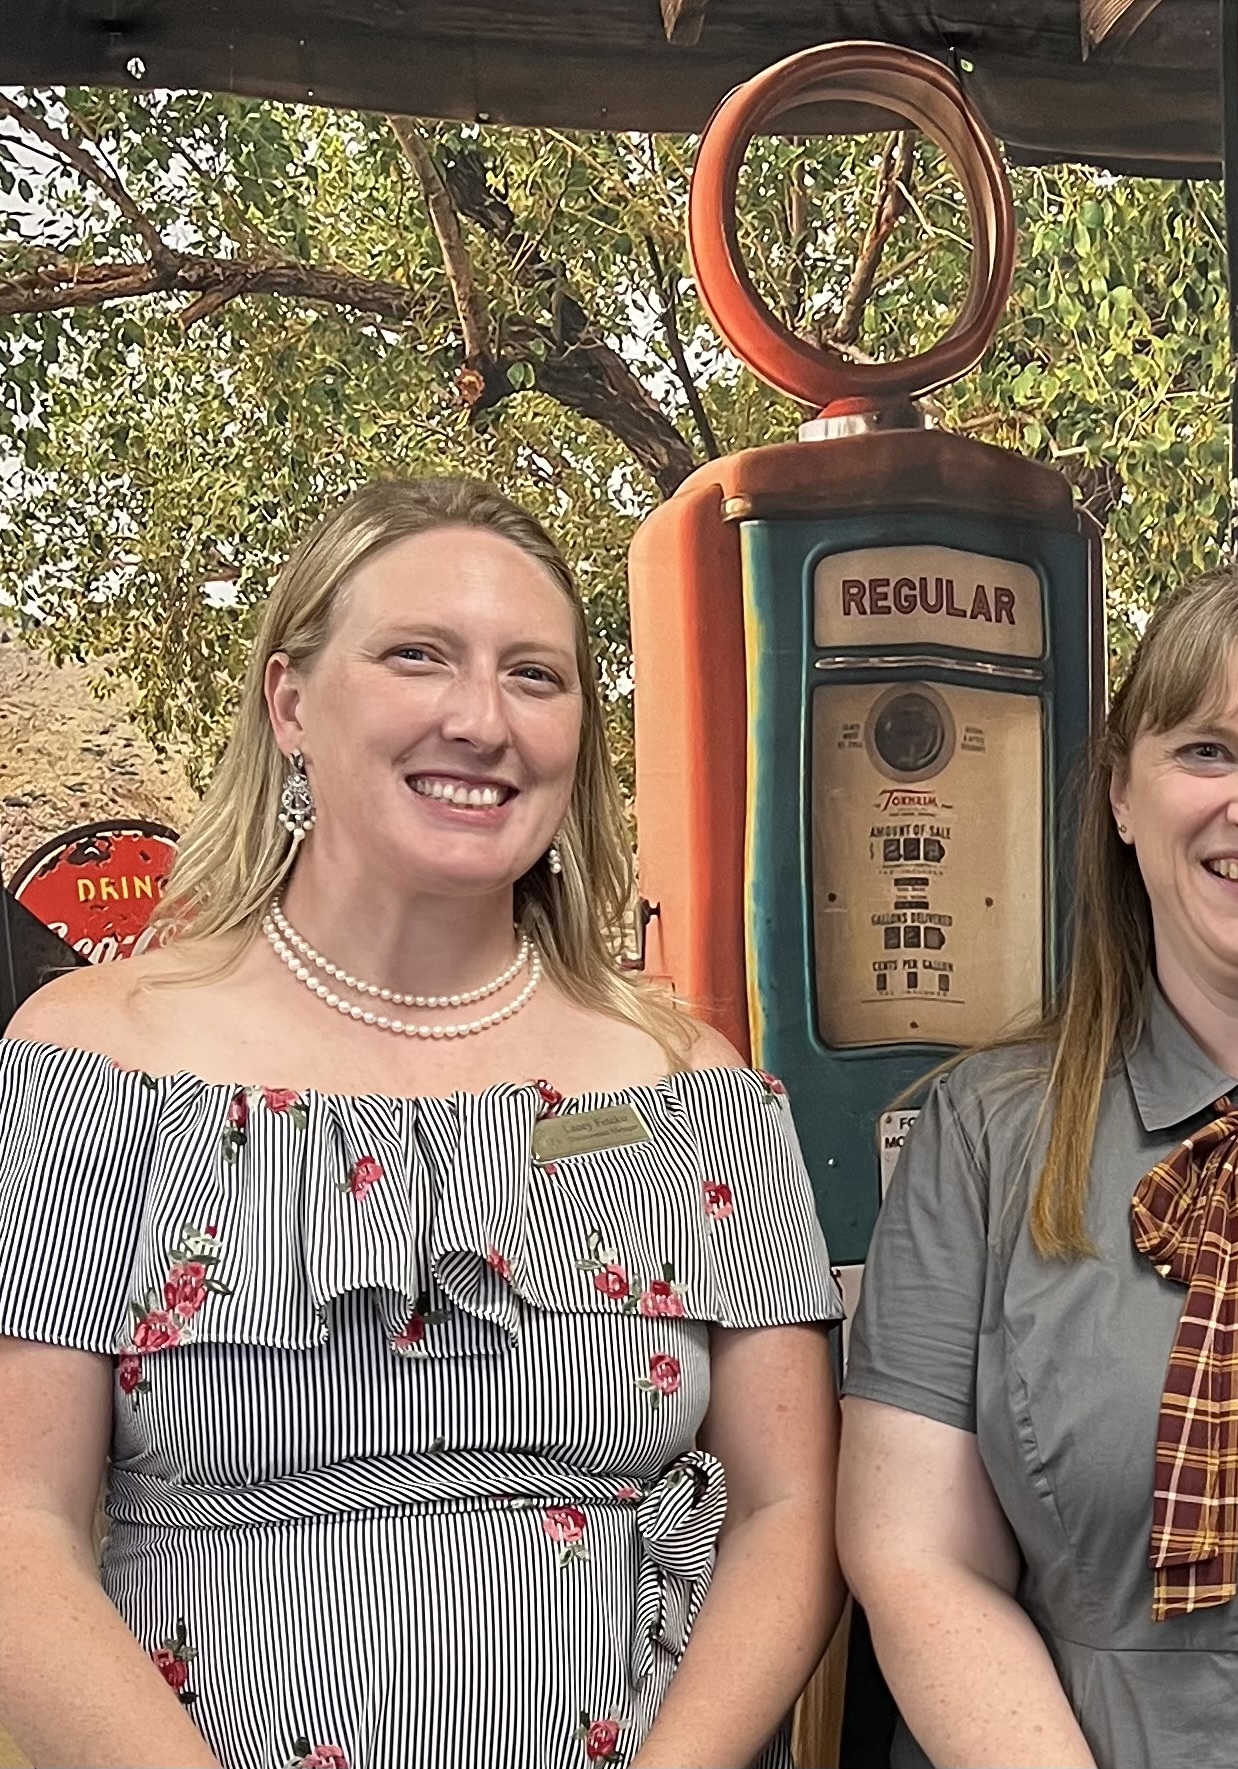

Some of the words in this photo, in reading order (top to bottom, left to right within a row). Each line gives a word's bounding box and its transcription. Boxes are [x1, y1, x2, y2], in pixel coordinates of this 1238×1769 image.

[841, 576, 1017, 626] REGULAR
[869, 825, 911, 839] AMOUNT
[912, 824, 926, 837] OF
[929, 825, 951, 840] SALE
[76, 875, 164, 902] DRIN
[871, 912, 908, 927] GALLONS
[910, 912, 953, 927] DELIVERED
[872, 959, 898, 972] CENTS
[902, 959, 918, 970] PER
[922, 959, 954, 973] GALLON
